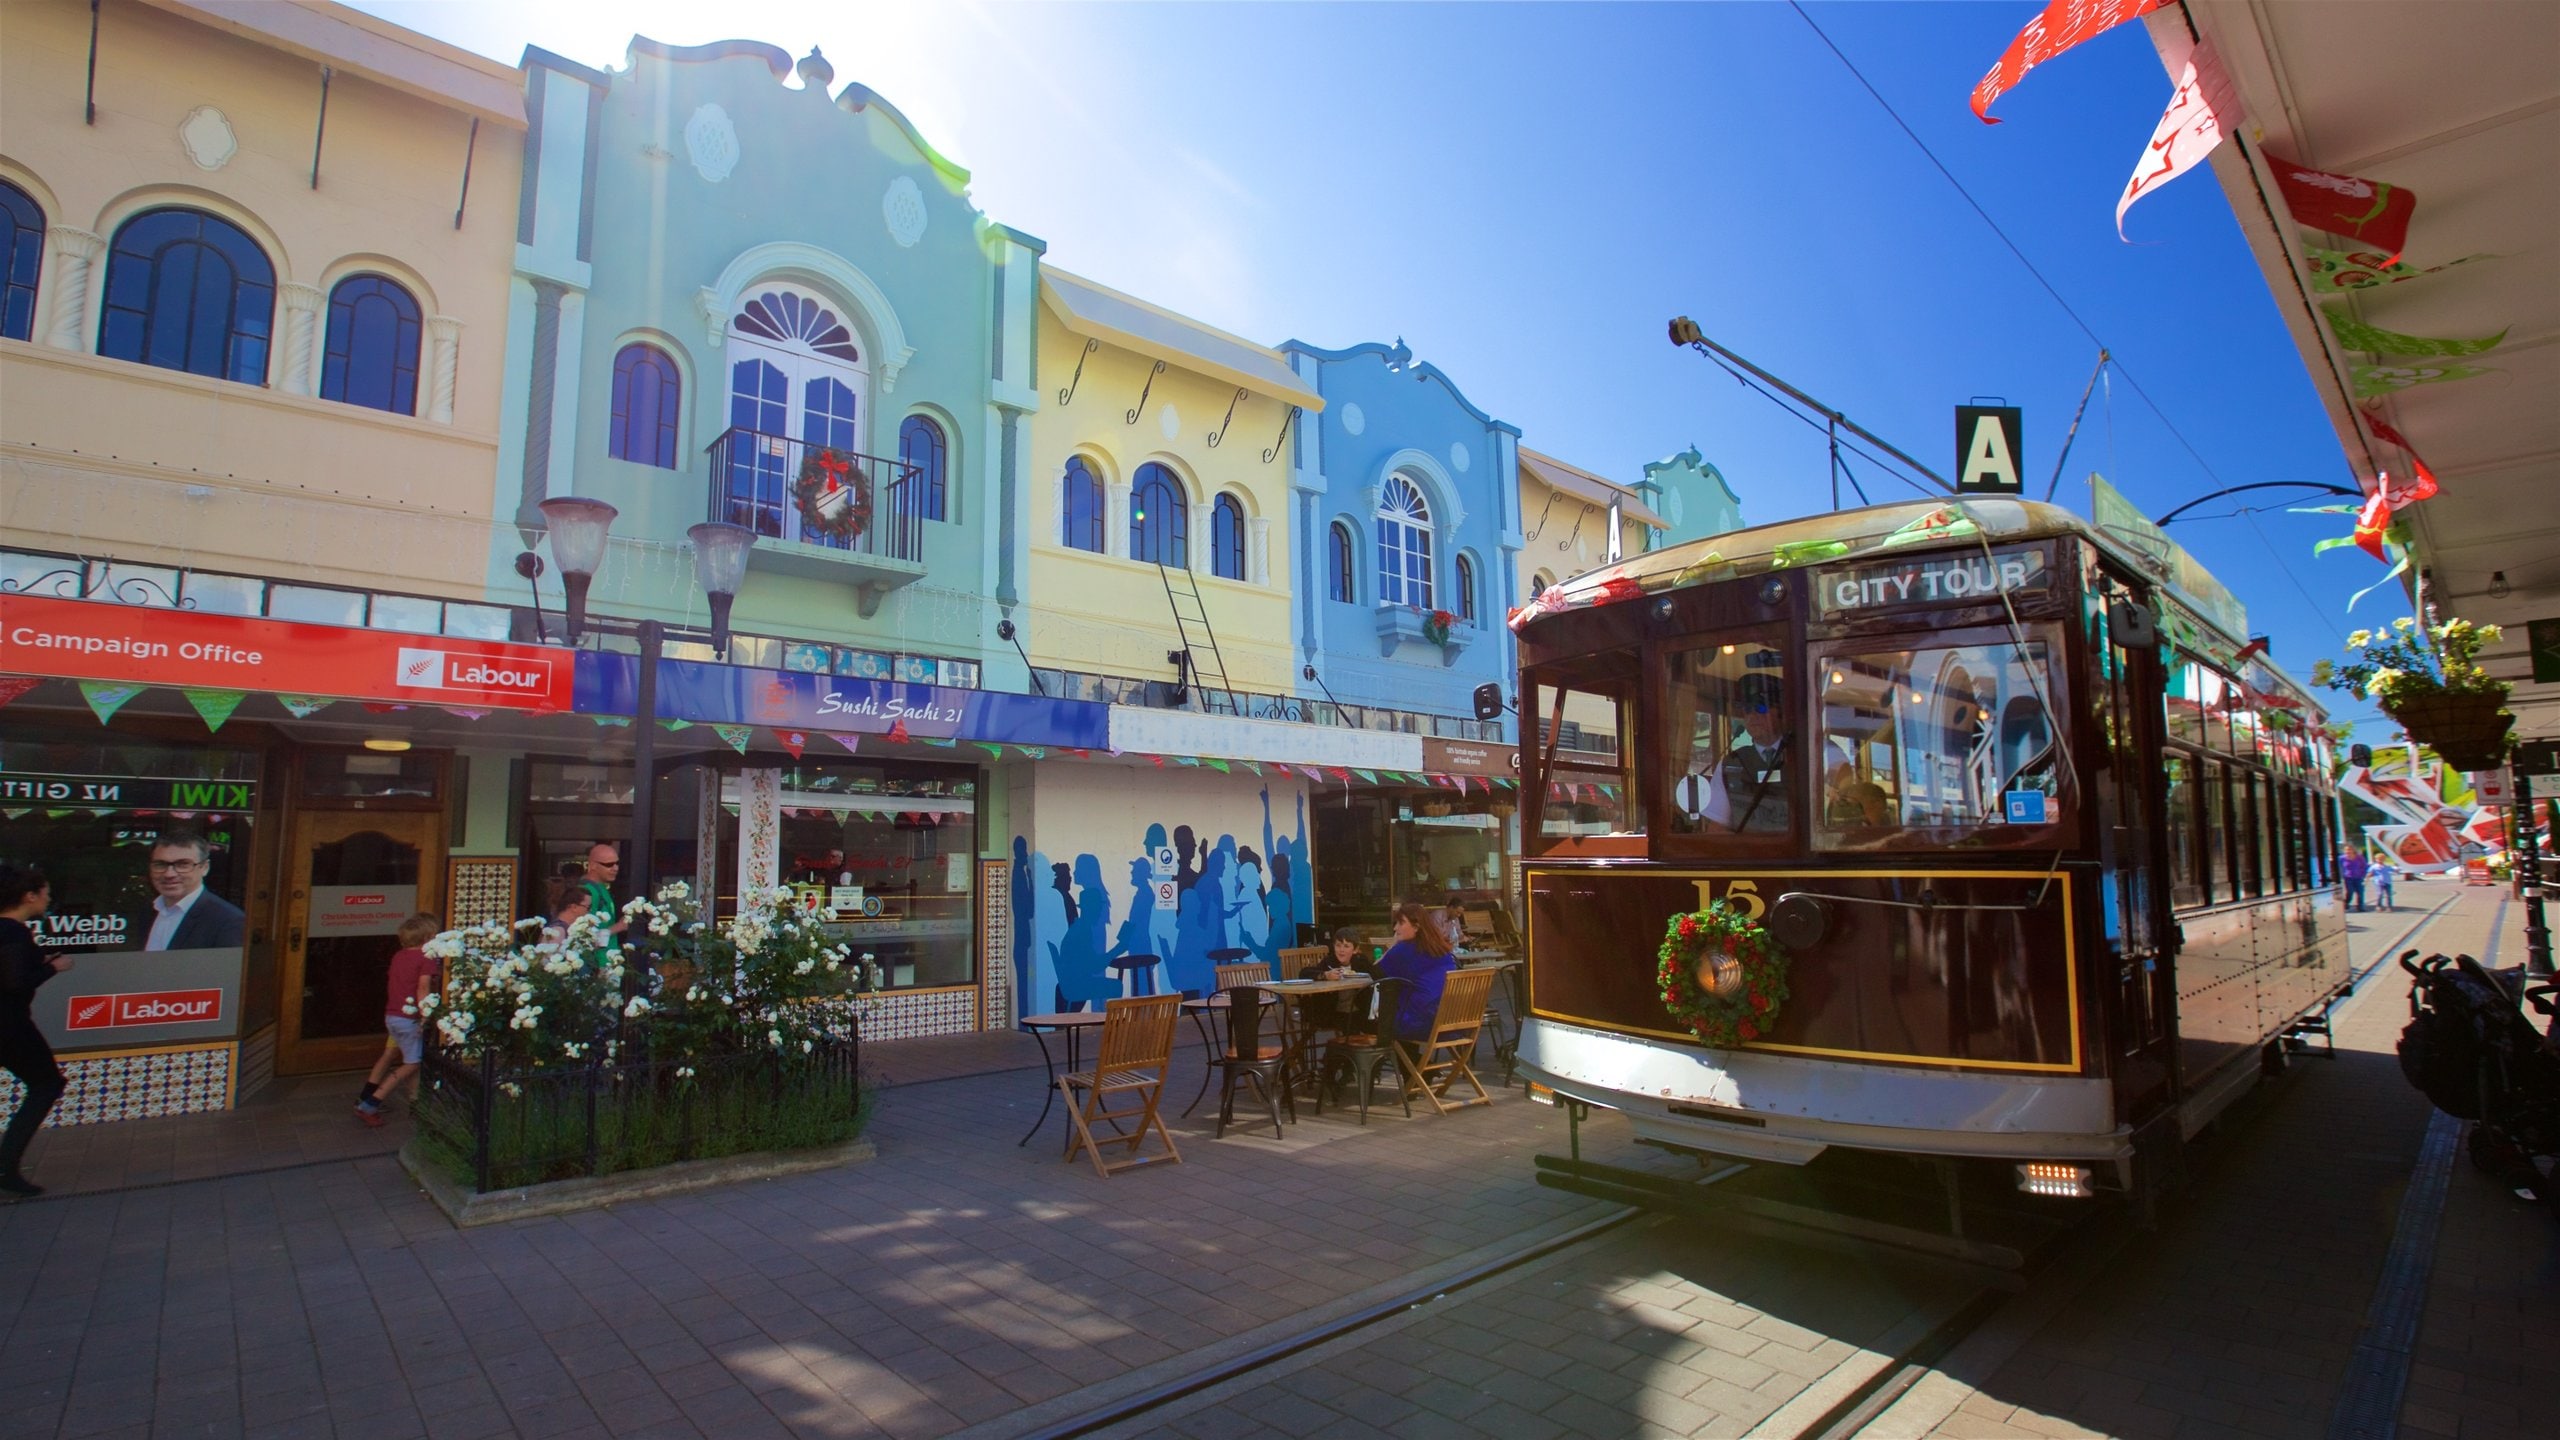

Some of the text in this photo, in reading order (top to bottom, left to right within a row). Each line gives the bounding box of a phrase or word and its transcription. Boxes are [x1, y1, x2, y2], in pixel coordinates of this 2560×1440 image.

[1962, 415, 2018, 484] A
[1607, 504, 1621, 565] A
[1836, 562, 2027, 607] CITY TOUR
[12, 627, 168, 658] Campaign
[179, 642, 263, 665] Office
[452, 662, 541, 688] Labour
[816, 692, 963, 723] Sushi Sachi 21
[1691, 880, 1766, 921] 15
[34, 933, 126, 947] Candidate
[49, 914, 127, 933] Webb
[121, 999, 212, 1020] Labour
